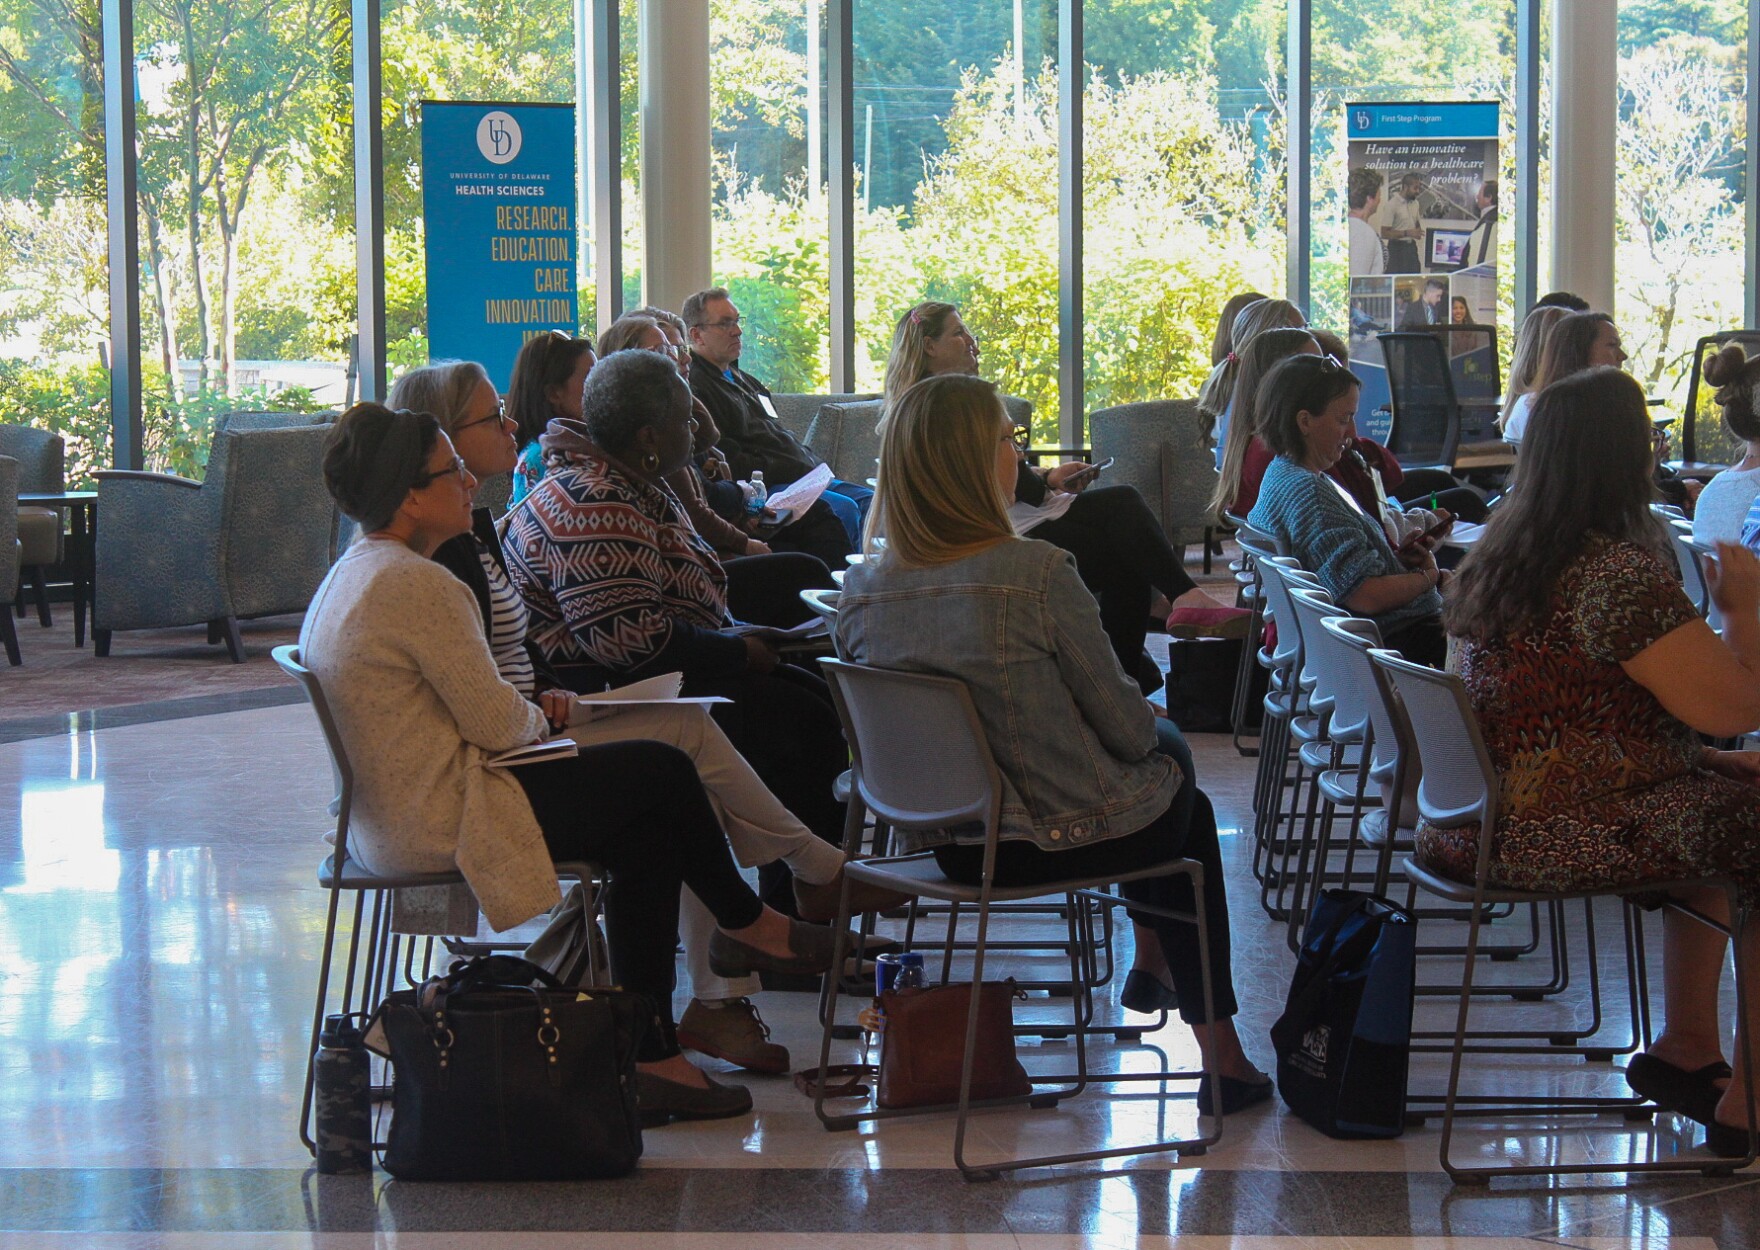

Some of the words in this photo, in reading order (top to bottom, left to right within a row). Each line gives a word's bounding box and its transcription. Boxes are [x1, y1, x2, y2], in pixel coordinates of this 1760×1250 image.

[1357, 111, 1370, 130] UD
[1397, 115, 1412, 123] Step
[1413, 115, 1442, 124] Program
[488, 119, 512, 156] UD
[1365, 143, 1395, 155] Have
[1395, 146, 1409, 154] an
[1411, 143, 1466, 154] innovative
[1364, 158, 1407, 170] solution
[1409, 160, 1420, 169] to
[1421, 161, 1429, 169] a
[1430, 157, 1485, 169] healthcare
[1429, 173, 1478, 188] problem?
[455, 185, 494, 195] HEALTH
[497, 186, 545, 196] SCIENCES
[496, 205, 572, 231] RESEARCH.
[491, 236, 573, 262] EDUCATION.
[534, 267, 574, 293] CARE.
[485, 298, 575, 324] INNOVATION.
